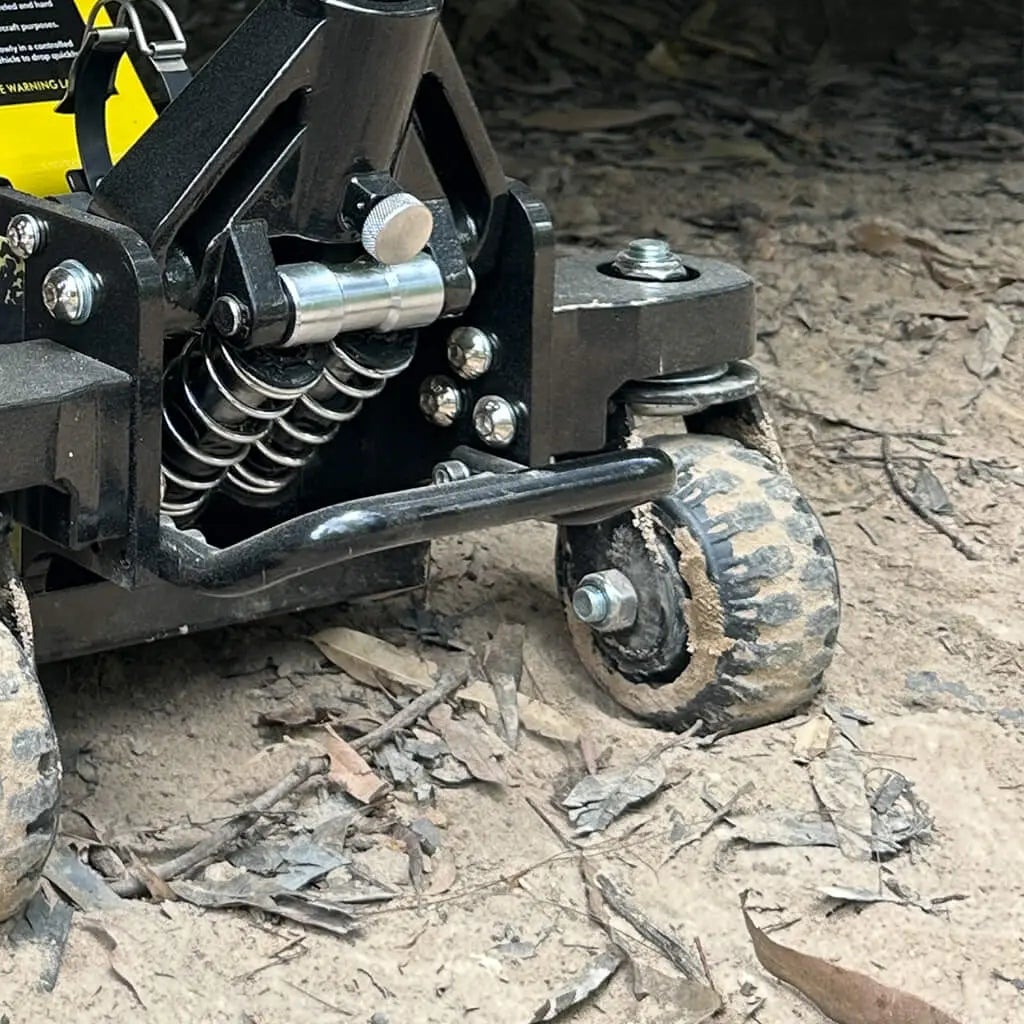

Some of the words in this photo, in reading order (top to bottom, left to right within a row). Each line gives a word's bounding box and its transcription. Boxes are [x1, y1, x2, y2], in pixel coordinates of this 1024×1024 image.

[18, 1, 35, 10] and
[33, 0, 54, 8] hard
[20, 21, 59, 32] purposes.
[17, 44, 28, 52] in
[33, 39, 74, 51] controlled
[31, 53, 51, 62] drop
[5, 79, 58, 93] WARNING
